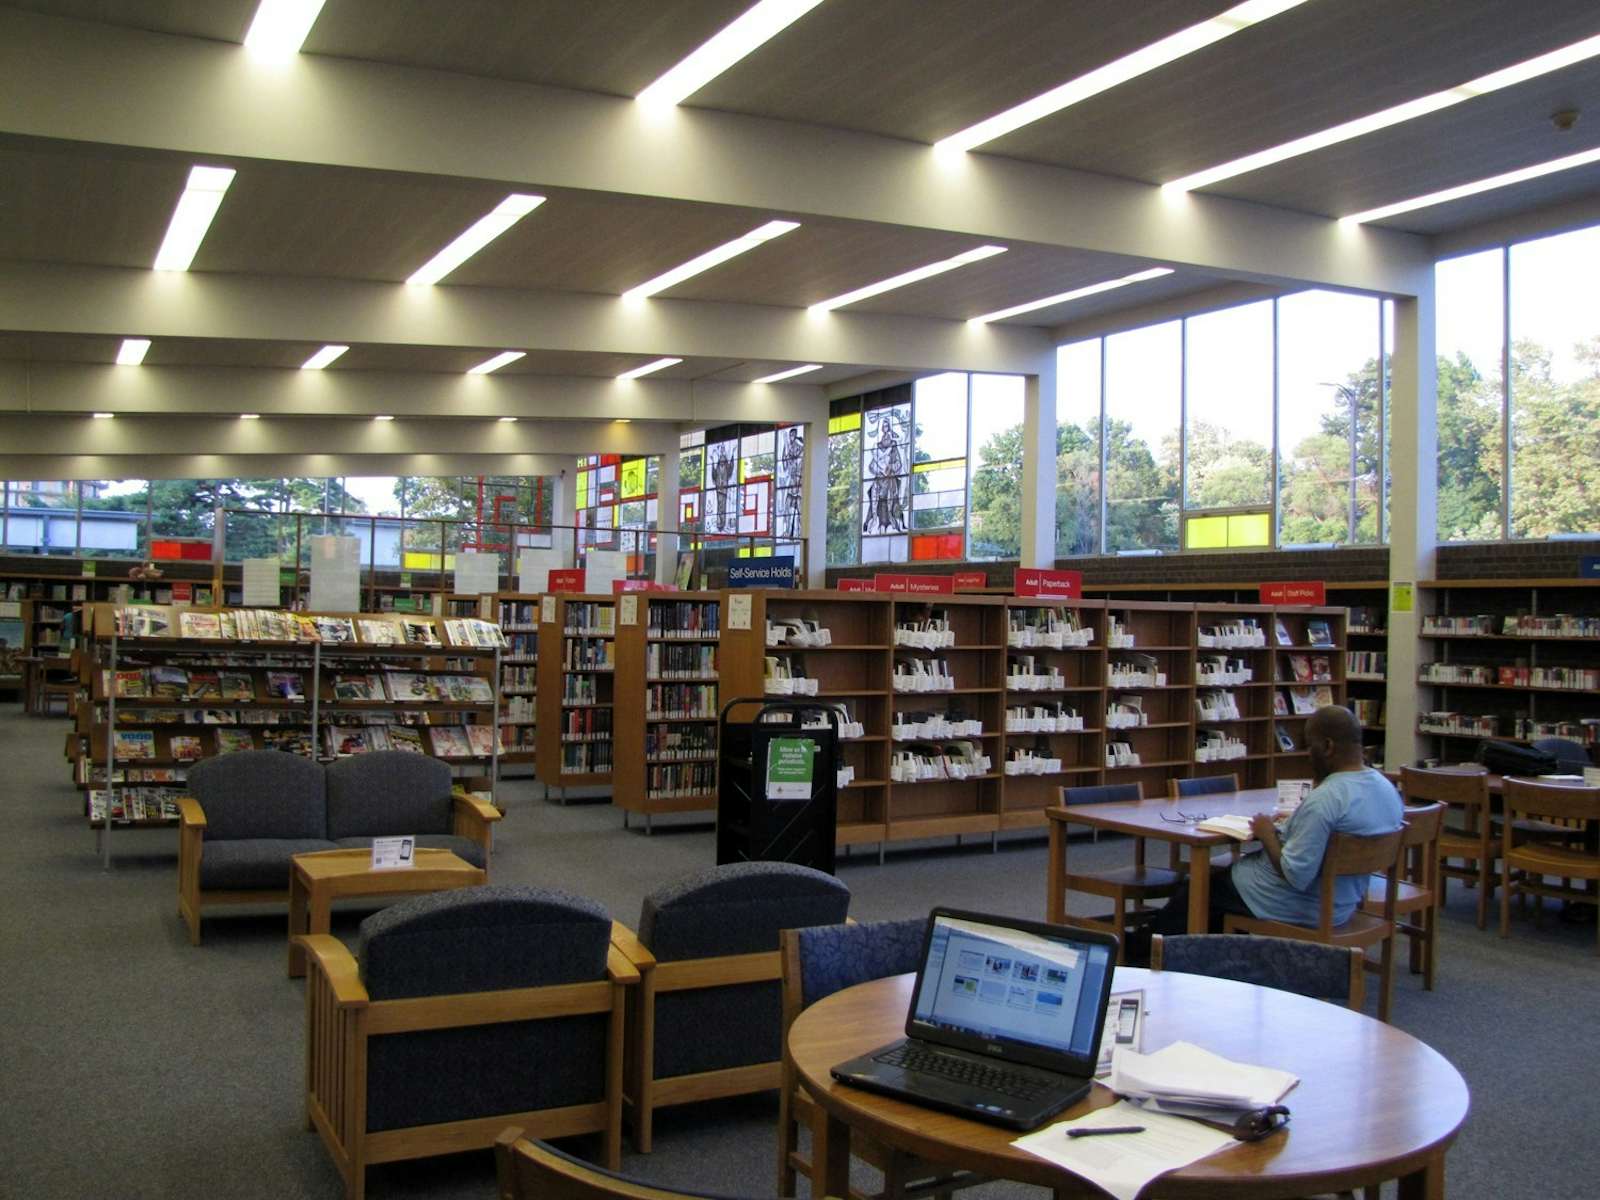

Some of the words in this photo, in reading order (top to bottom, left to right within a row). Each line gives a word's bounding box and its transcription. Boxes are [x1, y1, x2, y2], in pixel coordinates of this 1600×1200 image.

[730, 567, 770, 579] Self-Service
[771, 566, 792, 578] Holds
[910, 583, 939, 592] Mysteries
[1042, 579, 1071, 588] Paperback
